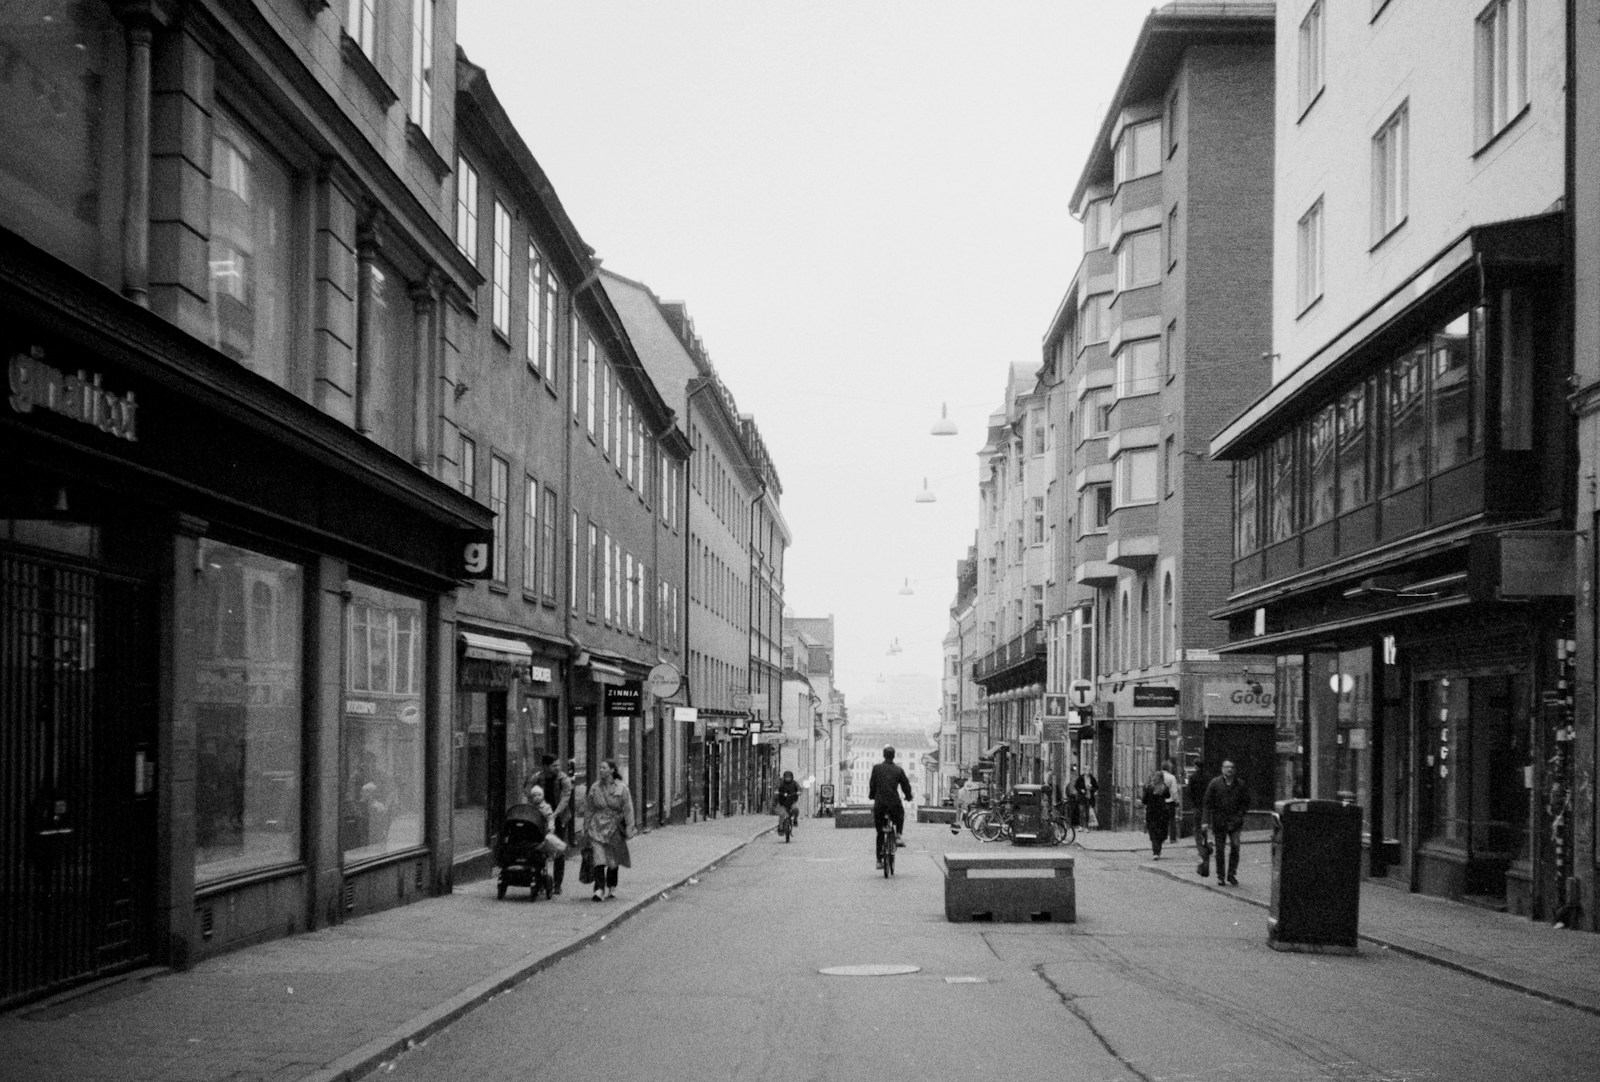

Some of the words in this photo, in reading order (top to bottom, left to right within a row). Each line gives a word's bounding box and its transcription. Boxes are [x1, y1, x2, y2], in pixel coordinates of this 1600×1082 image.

[463, 542, 488, 573] g
[607, 689, 639, 697] ZINNIA
[1075, 686, 1091, 704] T
